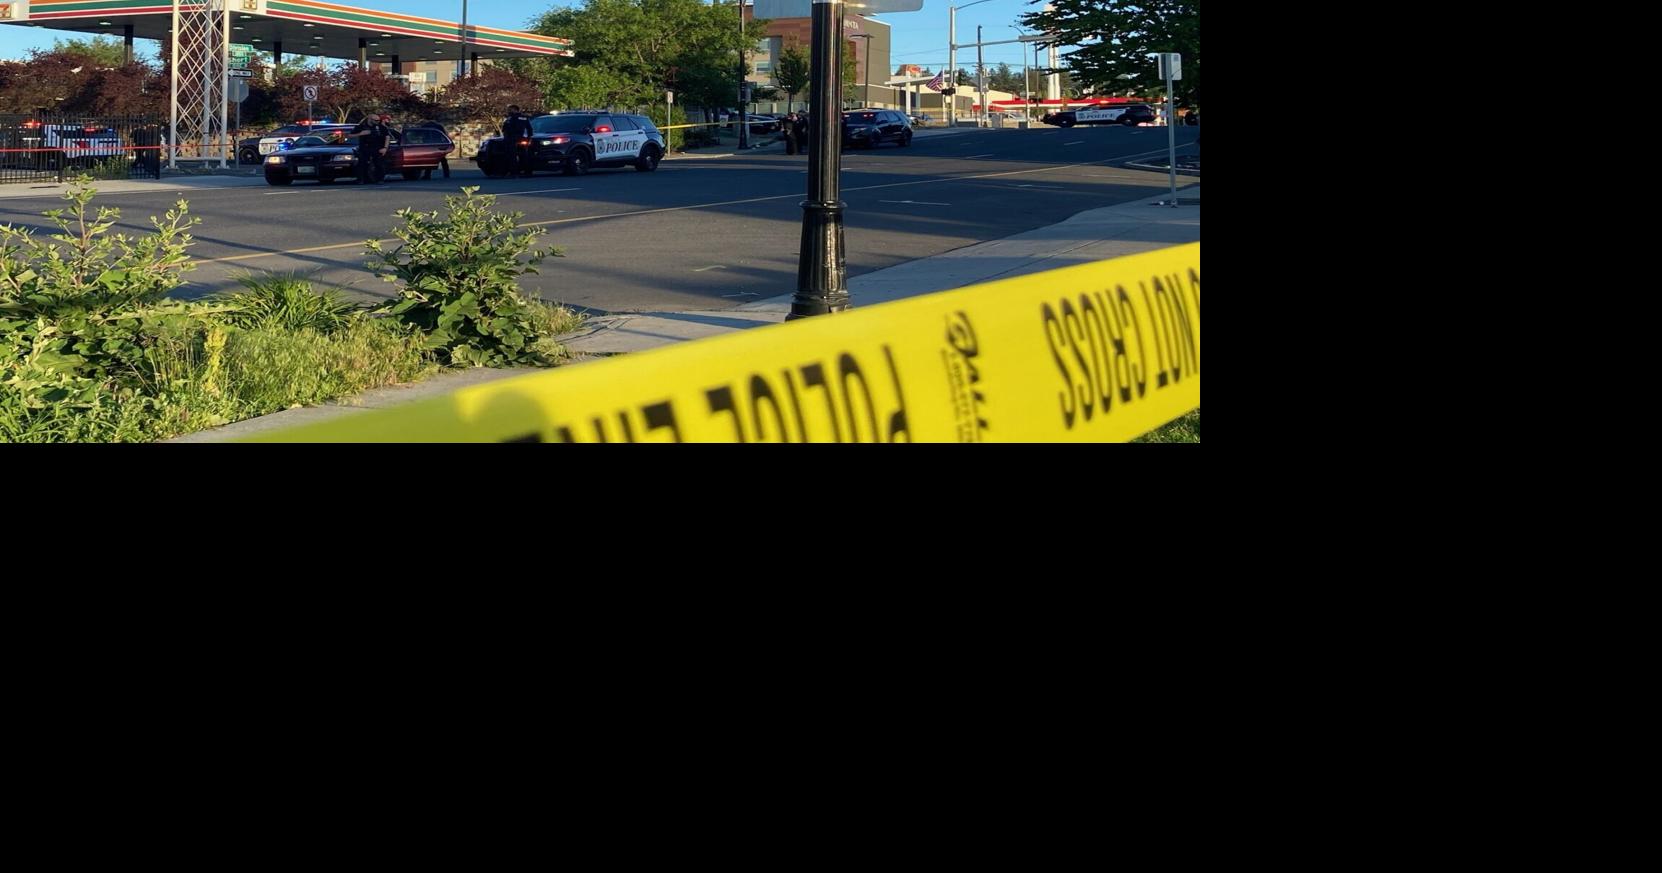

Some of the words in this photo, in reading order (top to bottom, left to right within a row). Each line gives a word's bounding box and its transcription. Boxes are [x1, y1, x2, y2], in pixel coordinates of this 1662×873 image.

[606, 140, 639, 153] POLICE
[1041, 283, 1147, 430] CROSS
[1138, 272, 1199, 389] NOT
